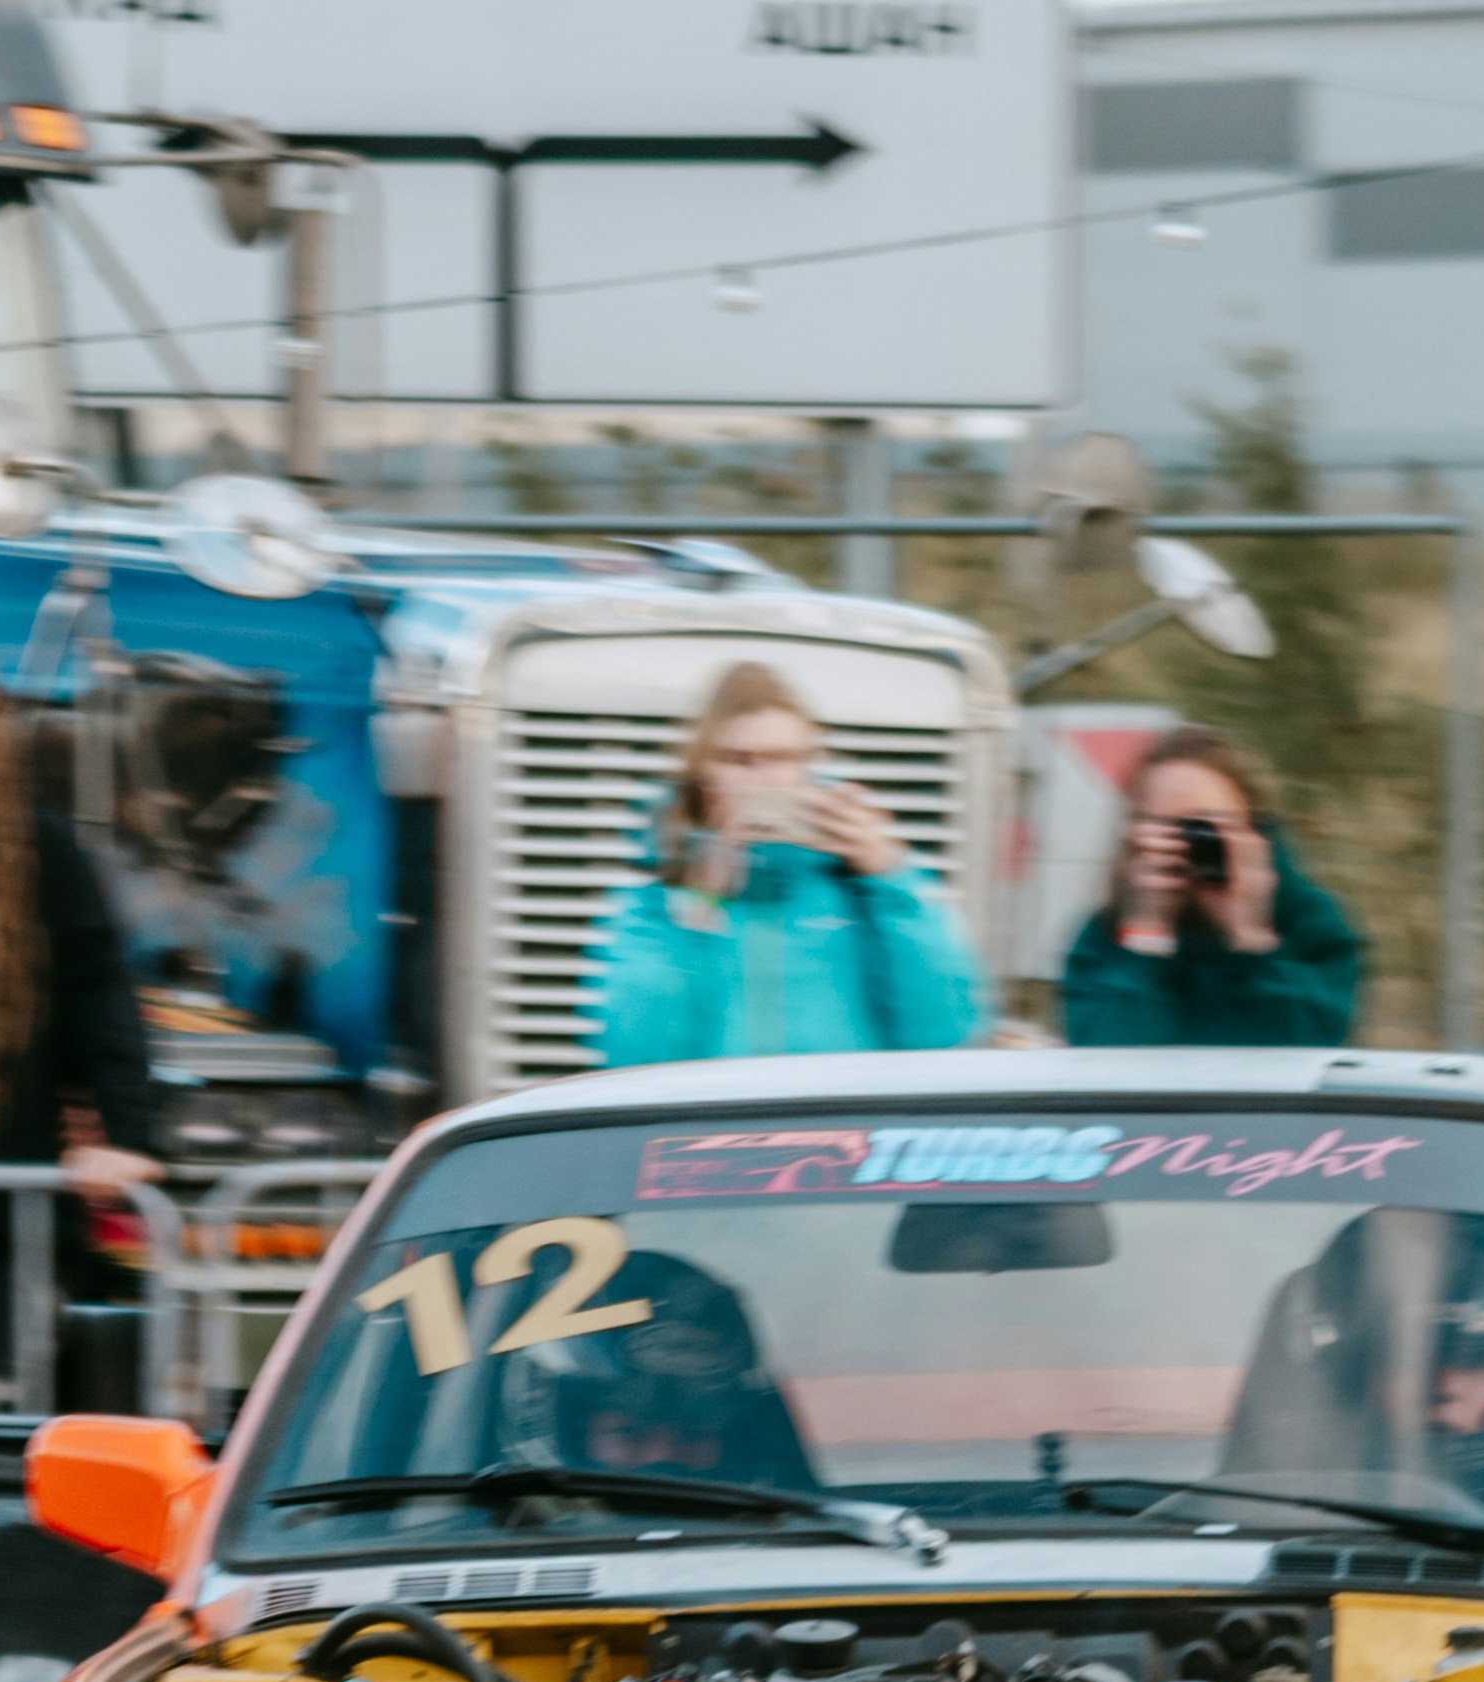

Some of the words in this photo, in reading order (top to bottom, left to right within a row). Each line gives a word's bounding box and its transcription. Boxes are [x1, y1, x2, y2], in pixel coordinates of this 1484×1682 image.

[744, 1, 977, 57] АШАН
[1103, 1128, 1423, 1196] Night
[353, 1216, 654, 1377] 12
